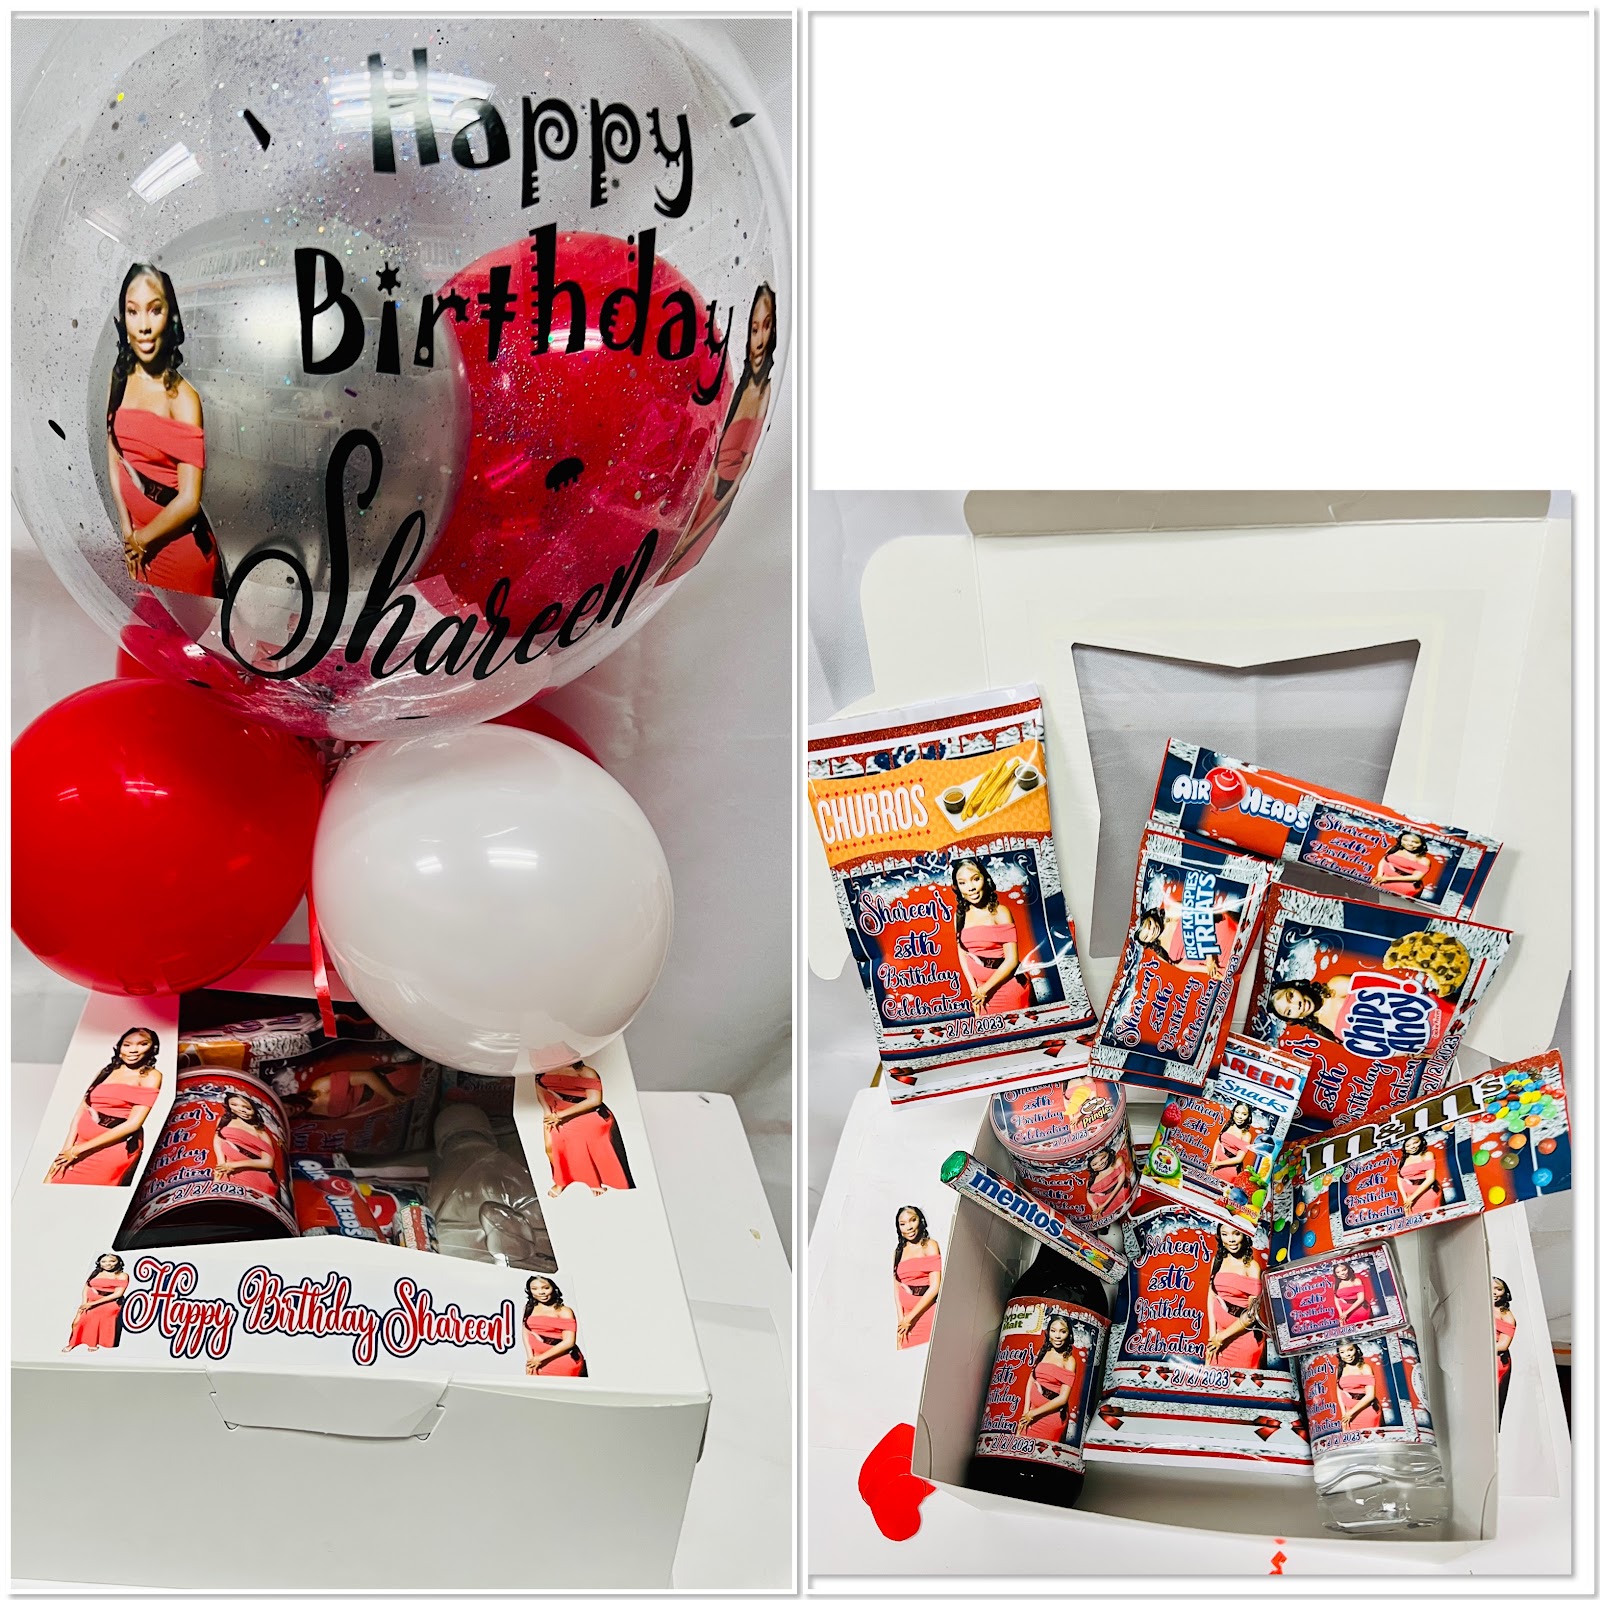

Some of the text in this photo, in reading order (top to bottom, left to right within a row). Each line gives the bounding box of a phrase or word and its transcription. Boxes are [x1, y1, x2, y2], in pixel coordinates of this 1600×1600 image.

[365, 47, 695, 219] Happy
[293, 222, 735, 406] Birthday
[220, 429, 660, 680] Shareen
[817, 782, 930, 845] CHURROS
[1172, 774, 1311, 833] AIR HEADS
[1314, 812, 1391, 849] Shareen's
[1309, 840, 1375, 874] Birthday
[860, 890, 953, 936] Shareen's
[1183, 871, 1199, 960] RICE KRISPIES
[1193, 871, 1222, 961] TREATS
[877, 961, 961, 991] Birthday
[882, 993, 973, 1020] Celebration
[1115, 957, 1160, 1047] Shareen's
[1157, 976, 1201, 1052] Birthday
[1178, 978, 1217, 1060] Celebration
[946, 1015, 1006, 1039] 2/2/2023
[1342, 989, 1393, 1059] Chips
[1221, 1053, 1295, 1091] REEN
[1421, 1034, 1462, 1093] 2/2/2023
[1221, 1079, 1290, 1114] Snacks
[1313, 1056, 1349, 1113] 28th
[1380, 1060, 1421, 1111] ration
[1010, 1110, 1064, 1128] Birthday
[1012, 1124, 1070, 1143] Celebration
[1081, 1105, 1115, 1128] Pringles
[1154, 1160, 1172, 1172] REAL
[1341, 1152, 1400, 1184] Shareen's
[174, 1181, 246, 1201] 2/2/2023
[968, 1170, 1065, 1240] mentos
[1343, 1187, 1399, 1208] Birthday
[1345, 1206, 1405, 1226] Celebration
[1133, 1235, 1213, 1268] Shareen's
[1148, 1263, 1199, 1292] 28th
[1284, 1277, 1333, 1300] Shareen's
[124, 1256, 514, 1366] Happy Birthday Shareen!
[1002, 1320, 1024, 1332] Malt
[1134, 1295, 1204, 1330] Birthday
[1289, 1305, 1335, 1321] Birthday
[1125, 1331, 1206, 1359] Celebration
[1171, 1364, 1232, 1389] 2/2/2023
[991, 1433, 1036, 1454] 2/2/2023
